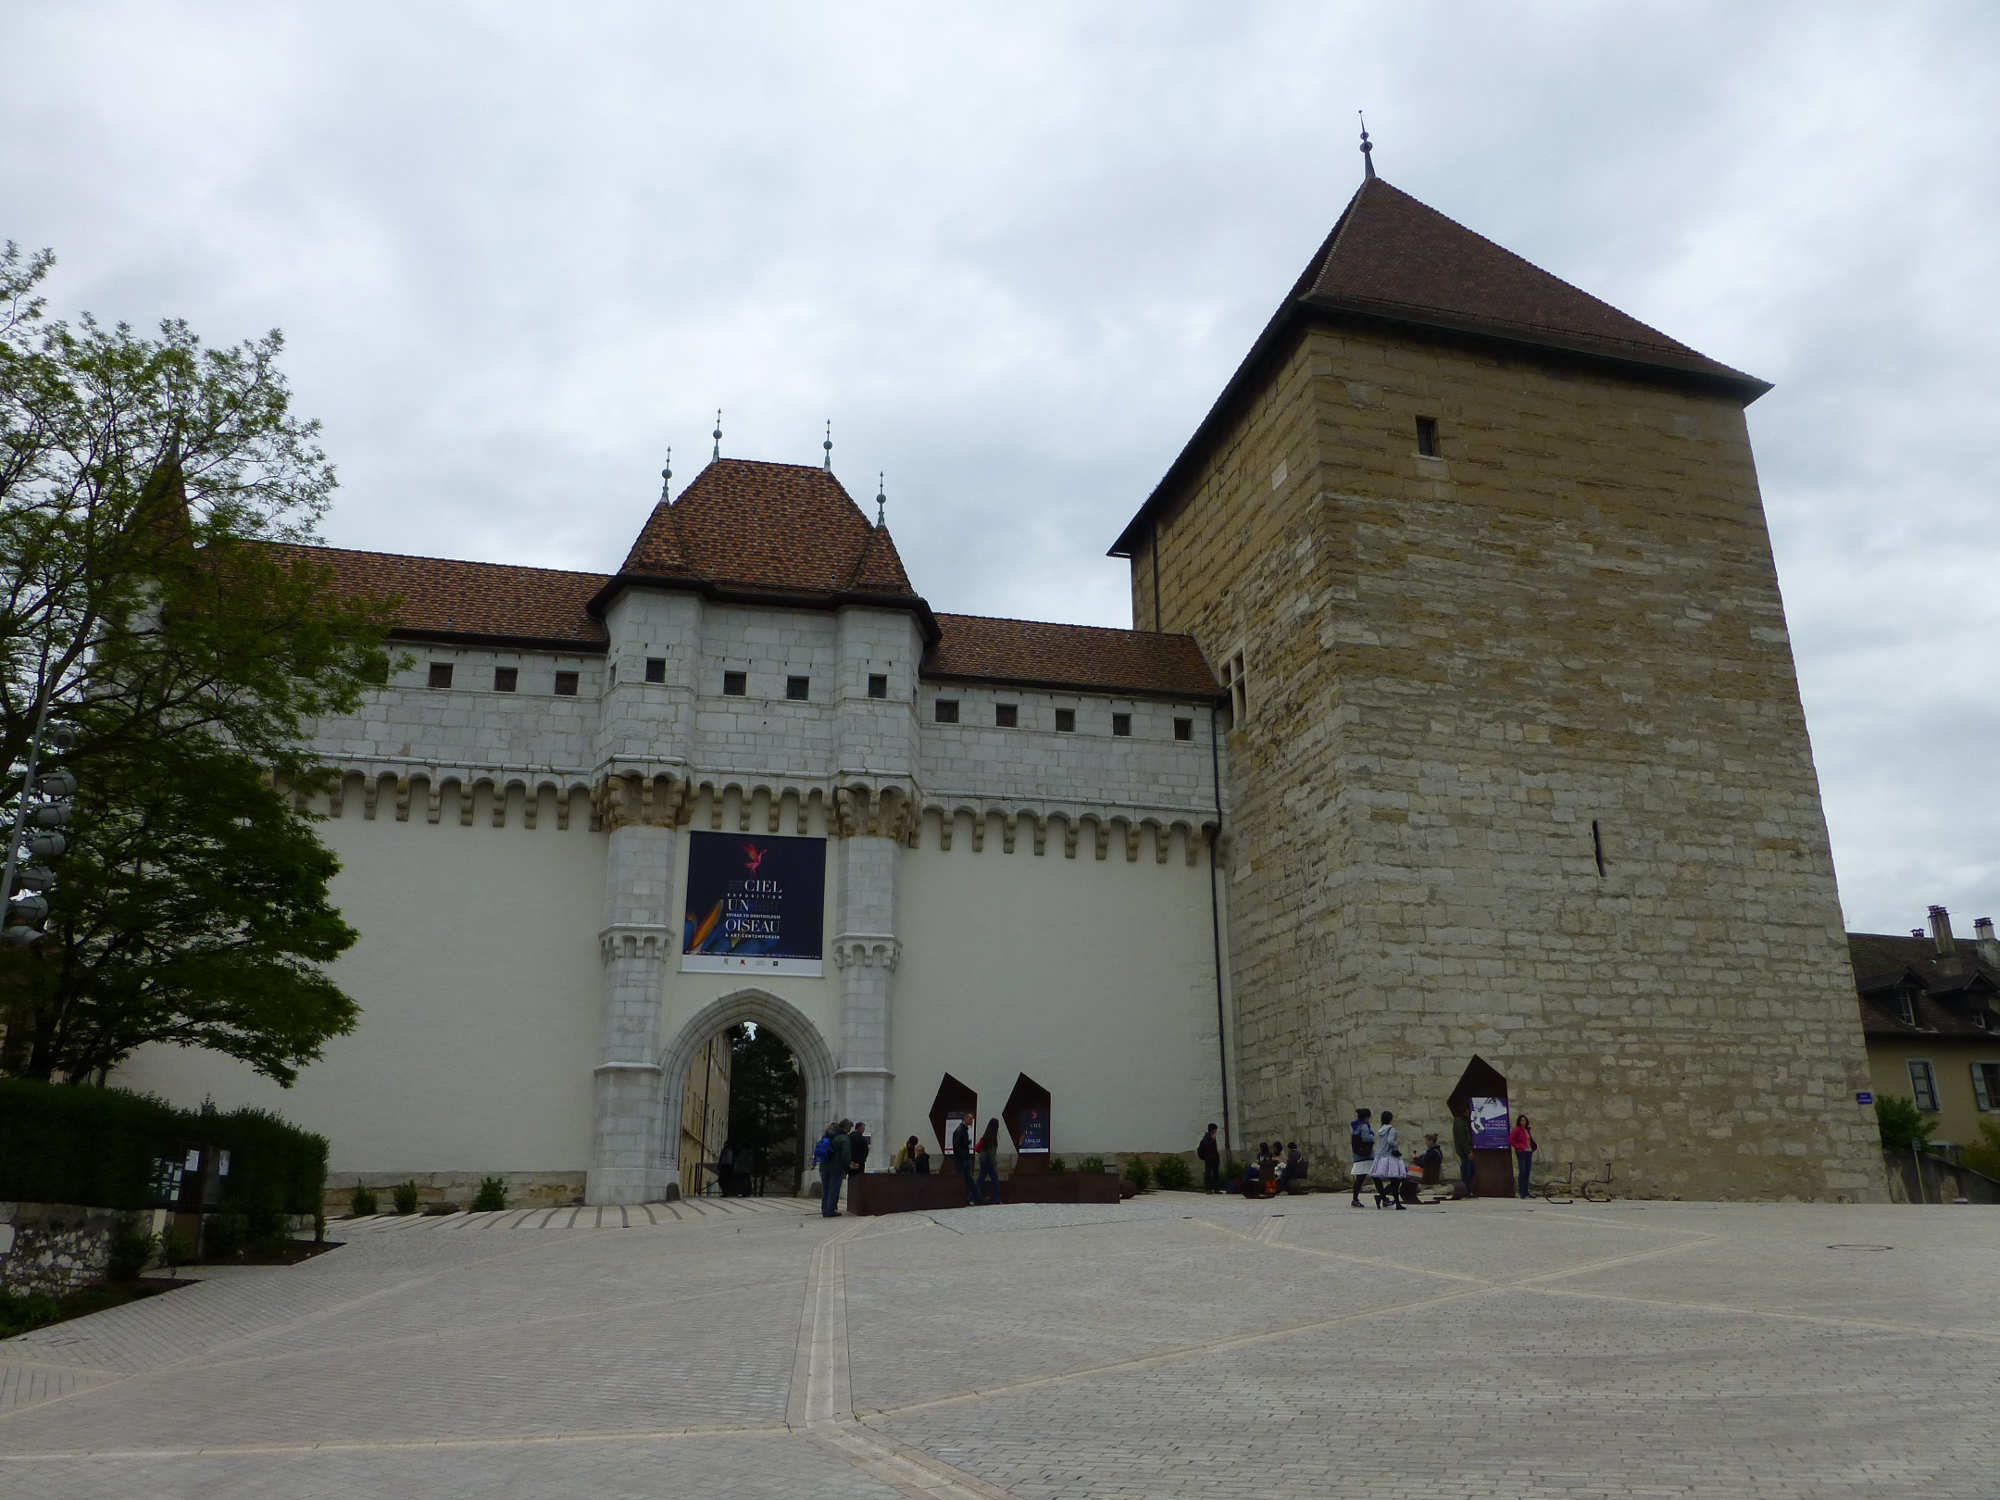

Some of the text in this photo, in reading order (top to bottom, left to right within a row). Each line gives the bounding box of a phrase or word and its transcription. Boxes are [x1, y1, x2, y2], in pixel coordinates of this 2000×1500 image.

[744, 880, 783, 893] CIEL
[728, 899, 749, 911] UN
[725, 919, 780, 933] OISEAU
